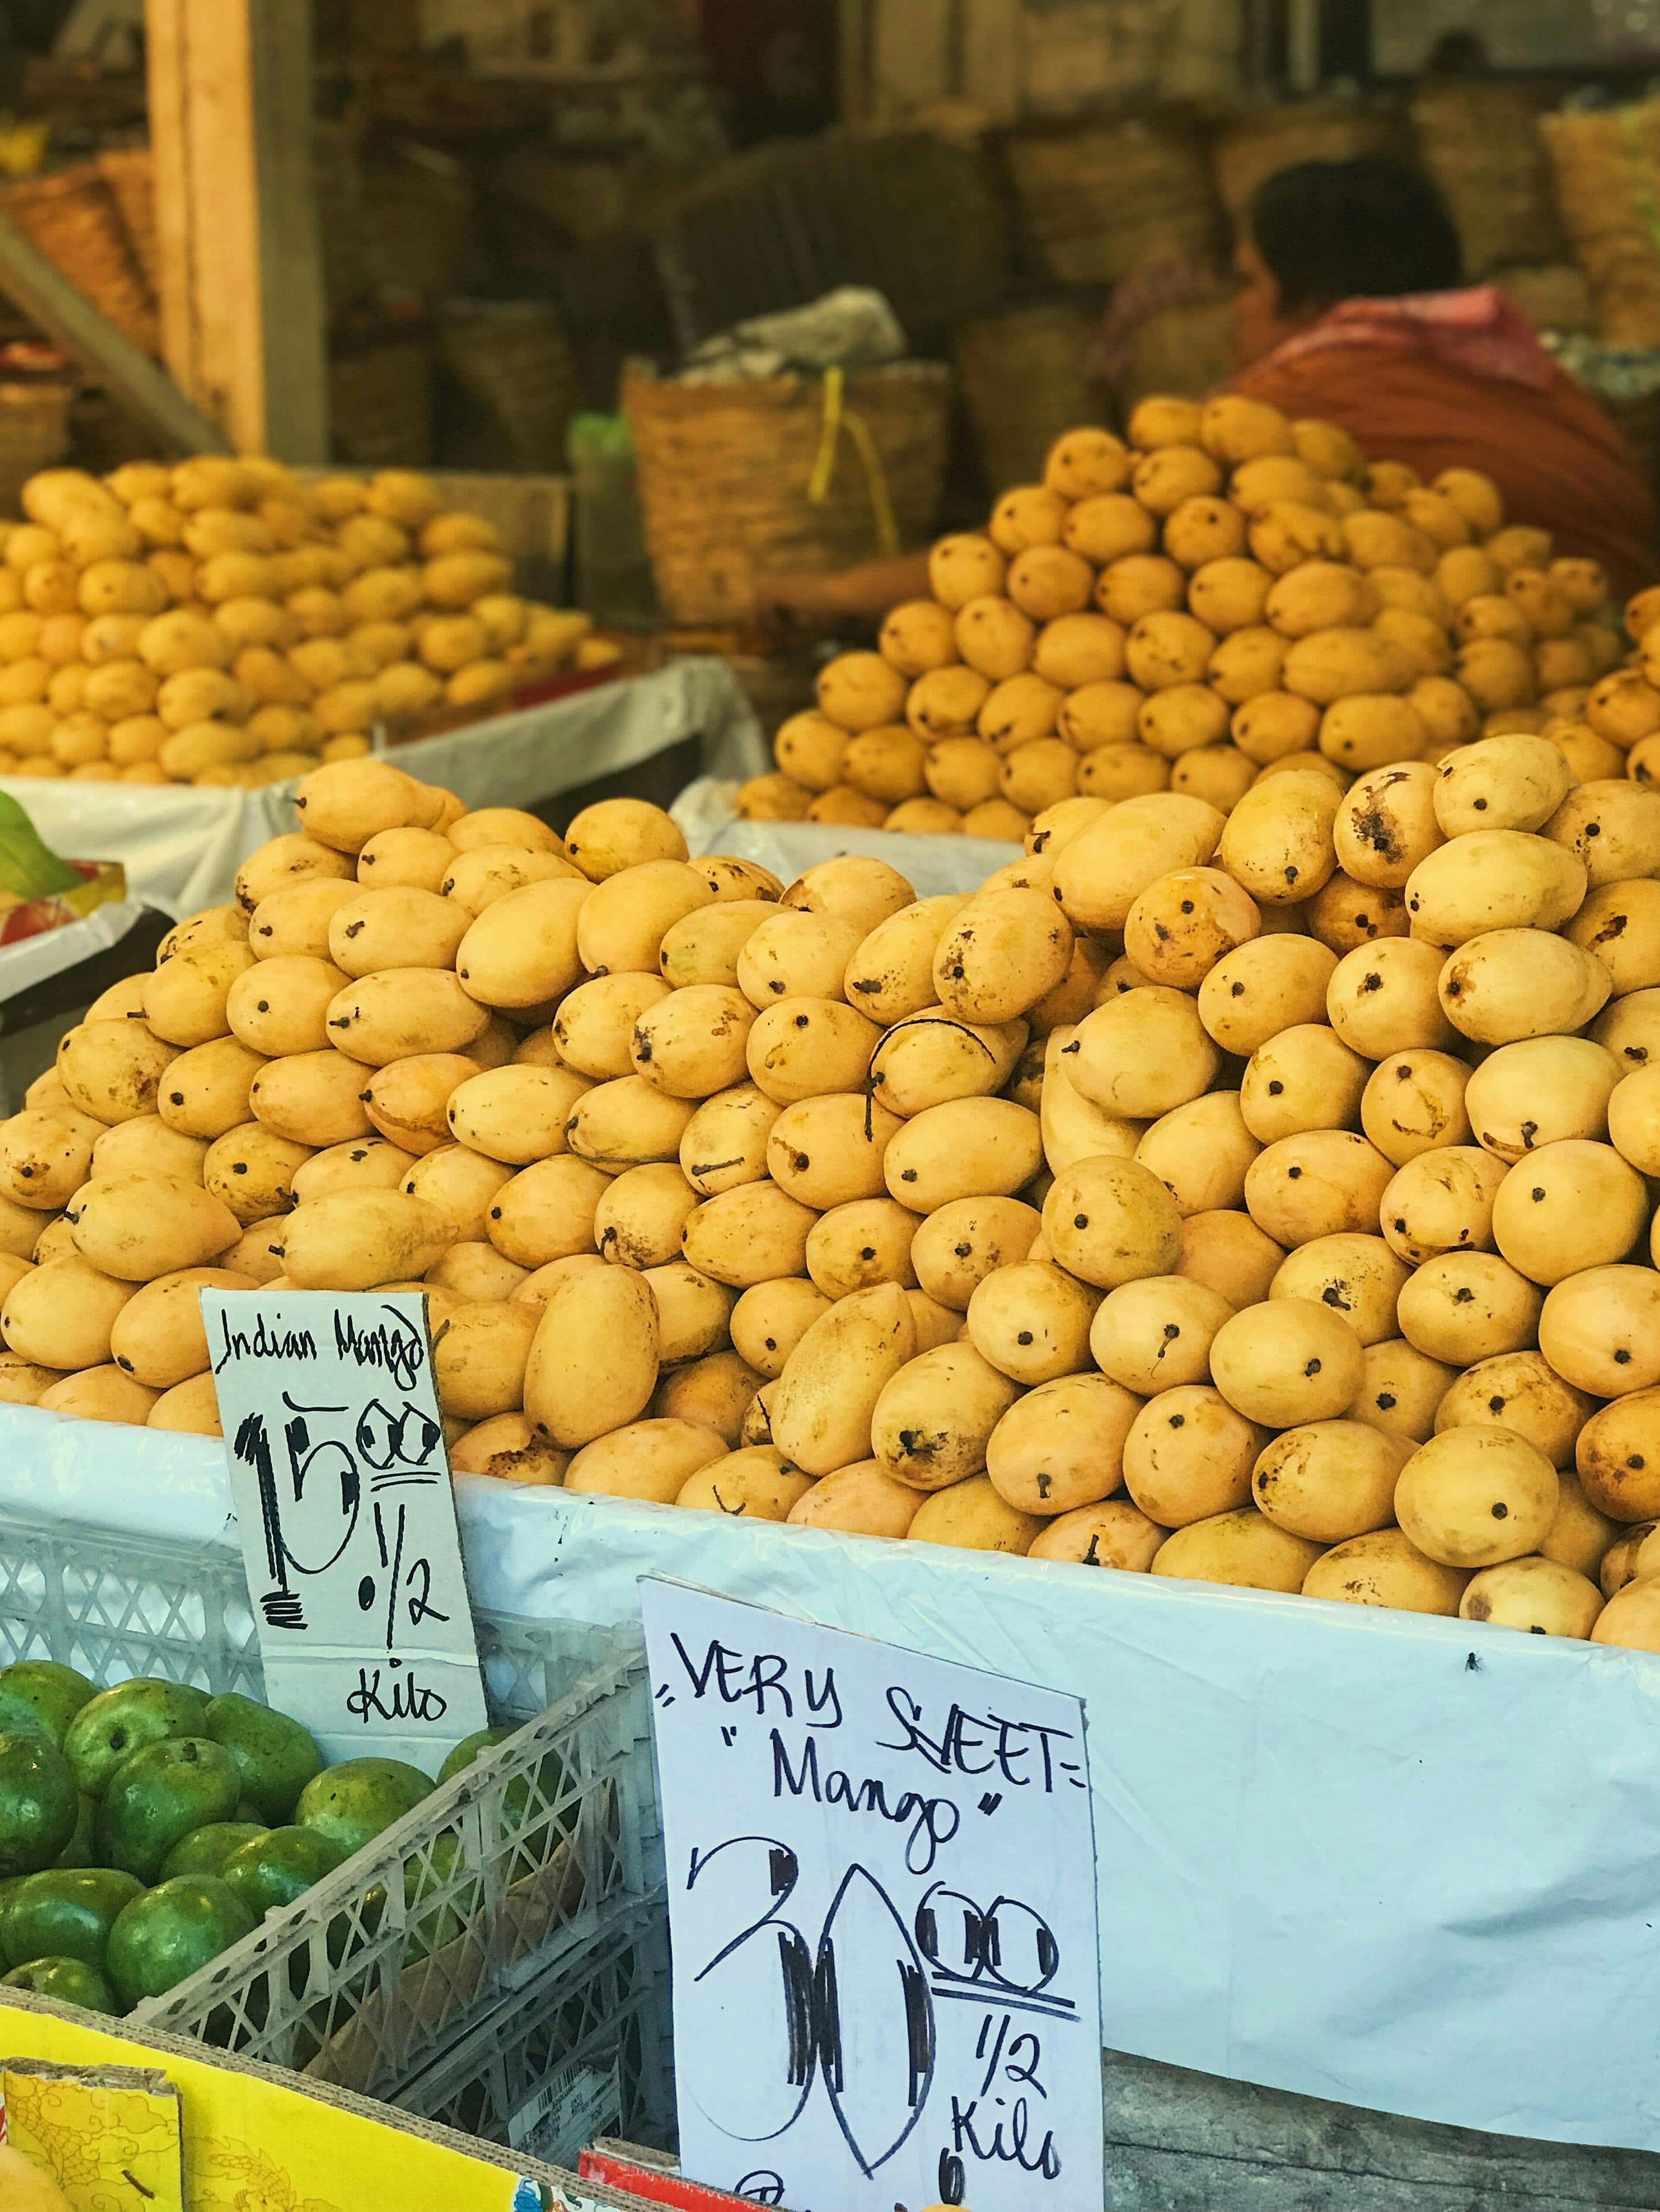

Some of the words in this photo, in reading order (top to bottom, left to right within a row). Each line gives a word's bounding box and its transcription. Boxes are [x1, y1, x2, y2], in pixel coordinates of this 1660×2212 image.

[215, 1308, 317, 1374] Indian
[334, 1304, 424, 1391] Mango
[347, 1657, 447, 1724] Kilo
[976, 2014, 1047, 2098] 1/2
